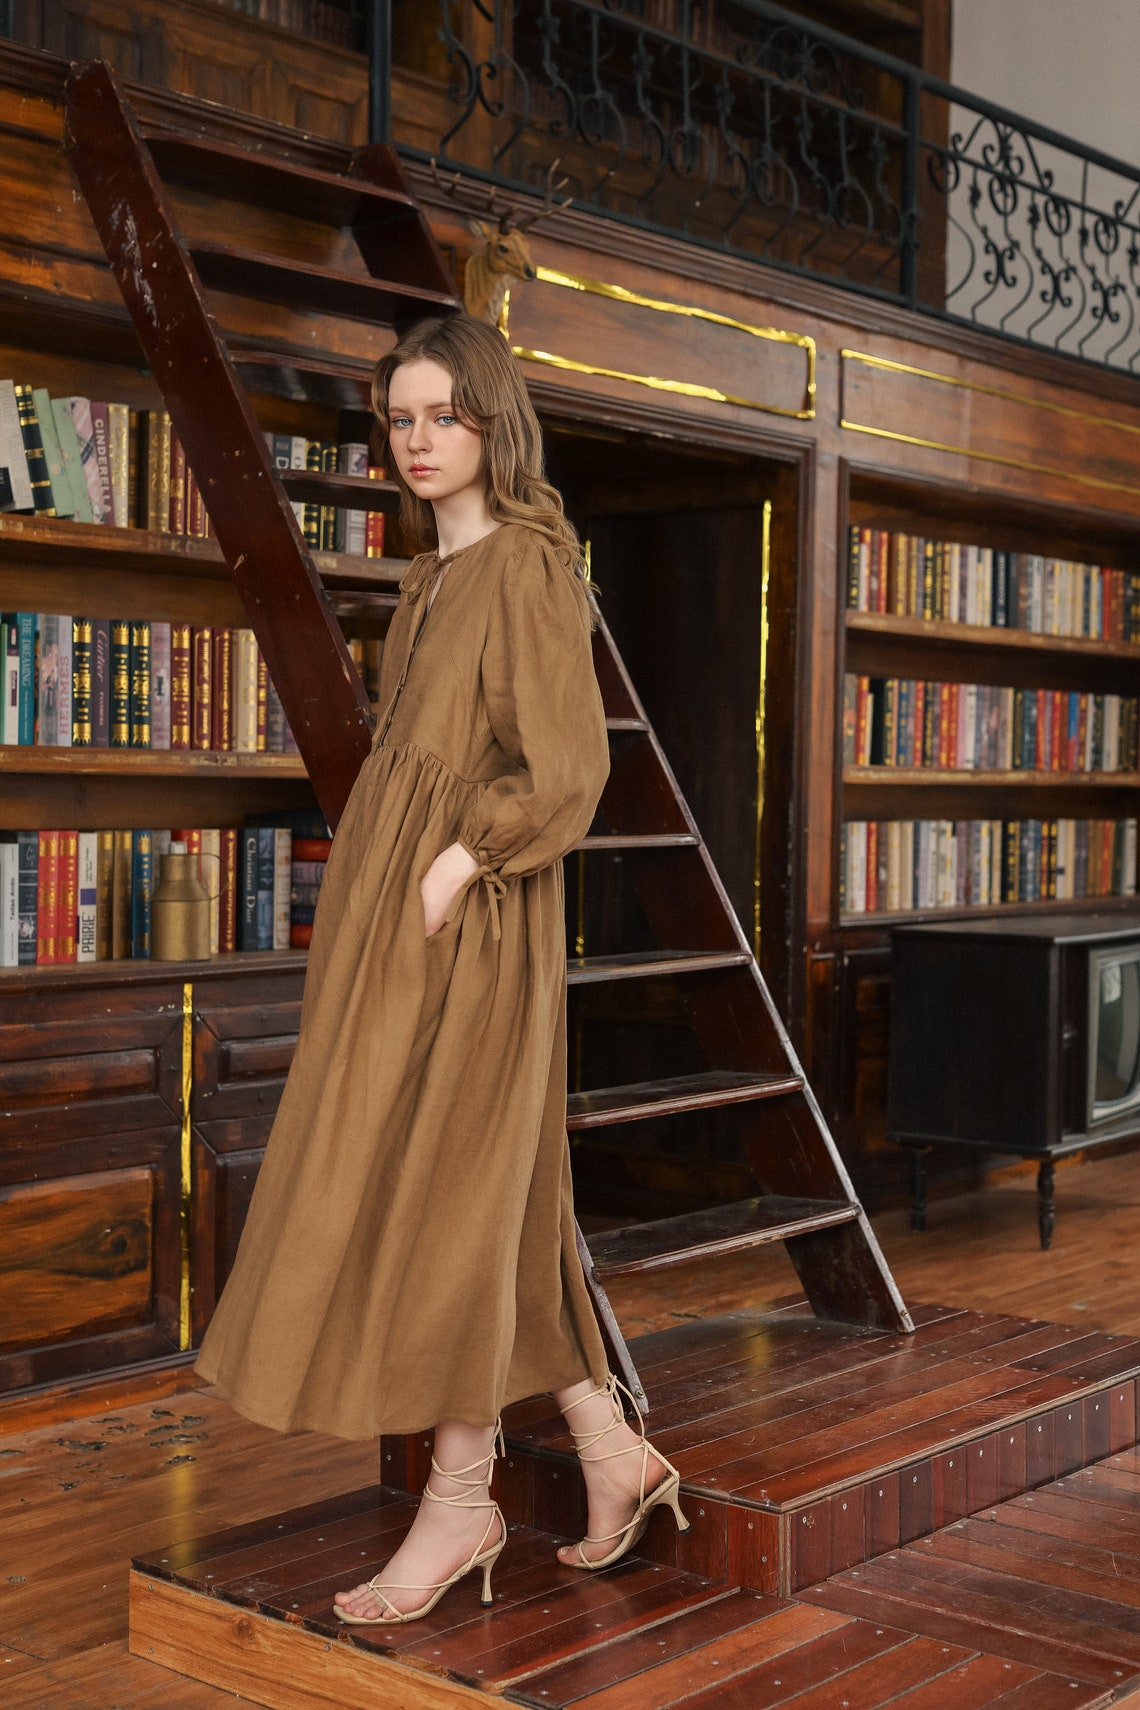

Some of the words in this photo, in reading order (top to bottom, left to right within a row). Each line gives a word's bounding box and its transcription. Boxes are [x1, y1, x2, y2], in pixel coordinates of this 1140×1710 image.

[94, 418, 112, 513] CINDERELLA
[22, 618, 32, 636] THE
[21, 638, 31, 687] DREAMING
[97, 629, 108, 682] Cartier
[60, 655, 69, 735] HERMES
[246, 837, 257, 891] Christian
[246, 895, 256, 923] Dior
